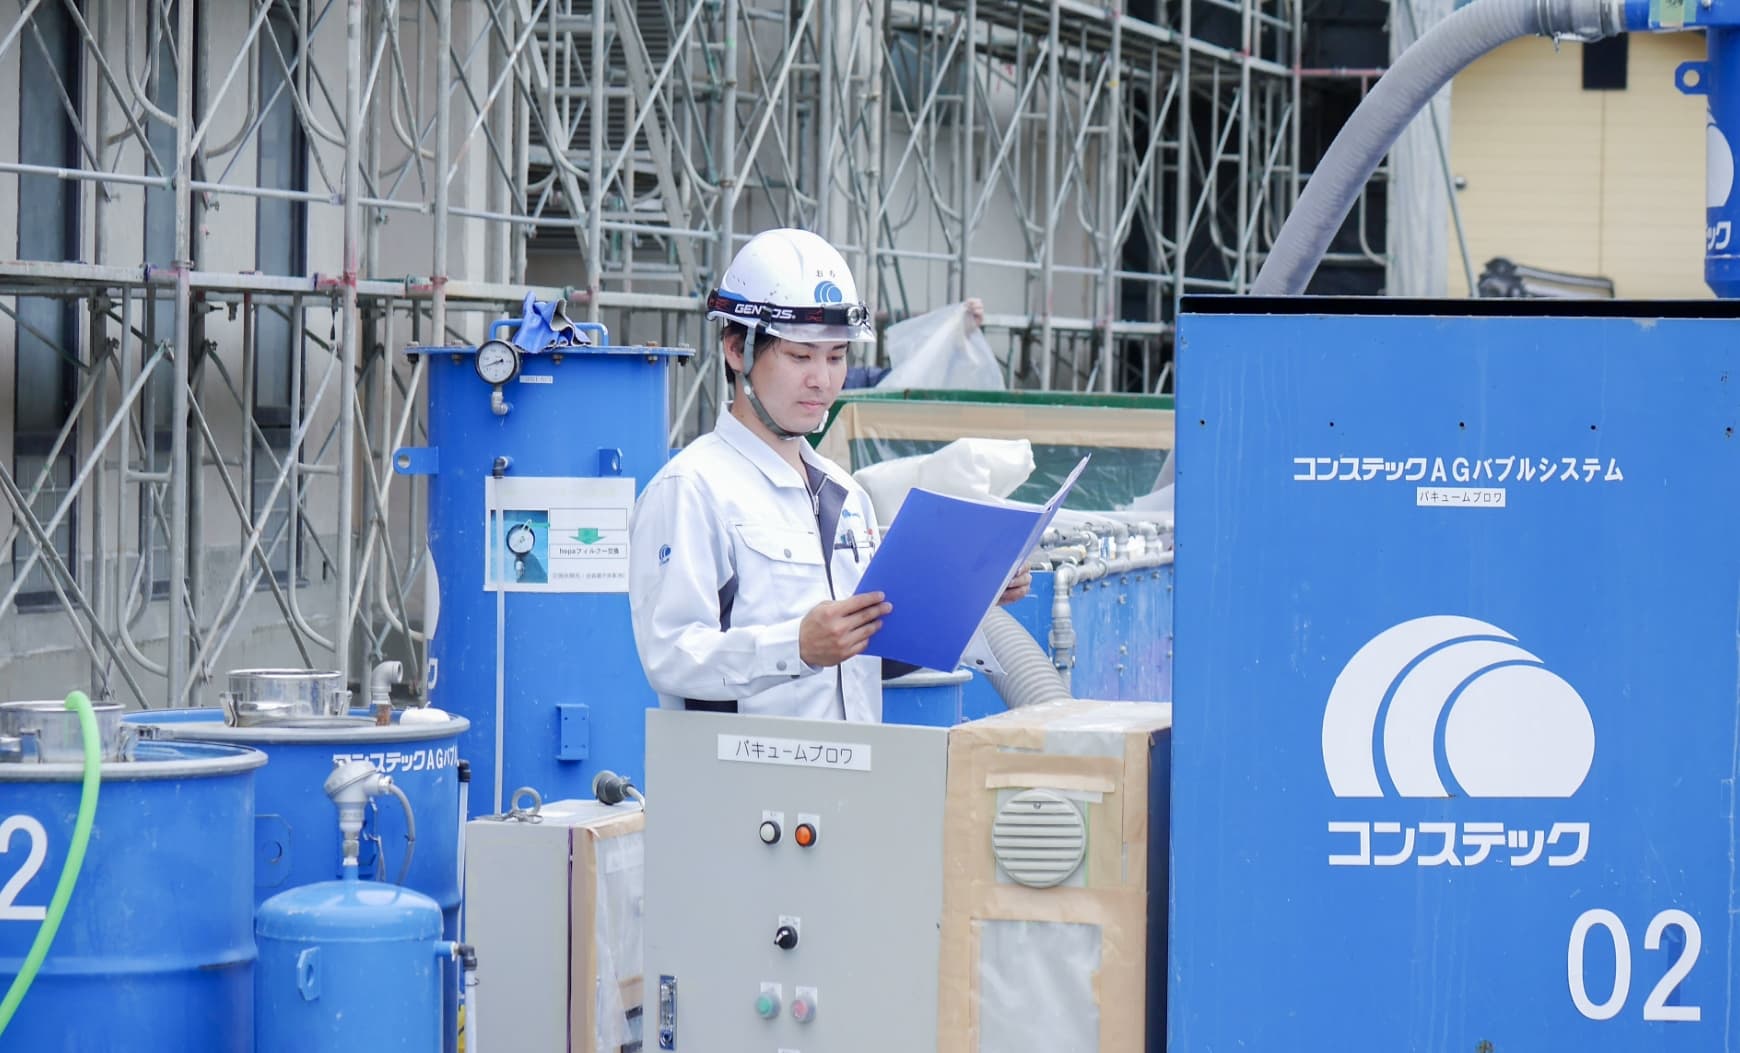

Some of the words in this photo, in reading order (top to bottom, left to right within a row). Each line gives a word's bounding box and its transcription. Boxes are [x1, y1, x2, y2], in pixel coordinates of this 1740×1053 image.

[1294, 455, 1625, 482] コンステックAGバブルシステム
[1328, 821, 1591, 867] コンステック
[1567, 908, 1703, 1022] 02
